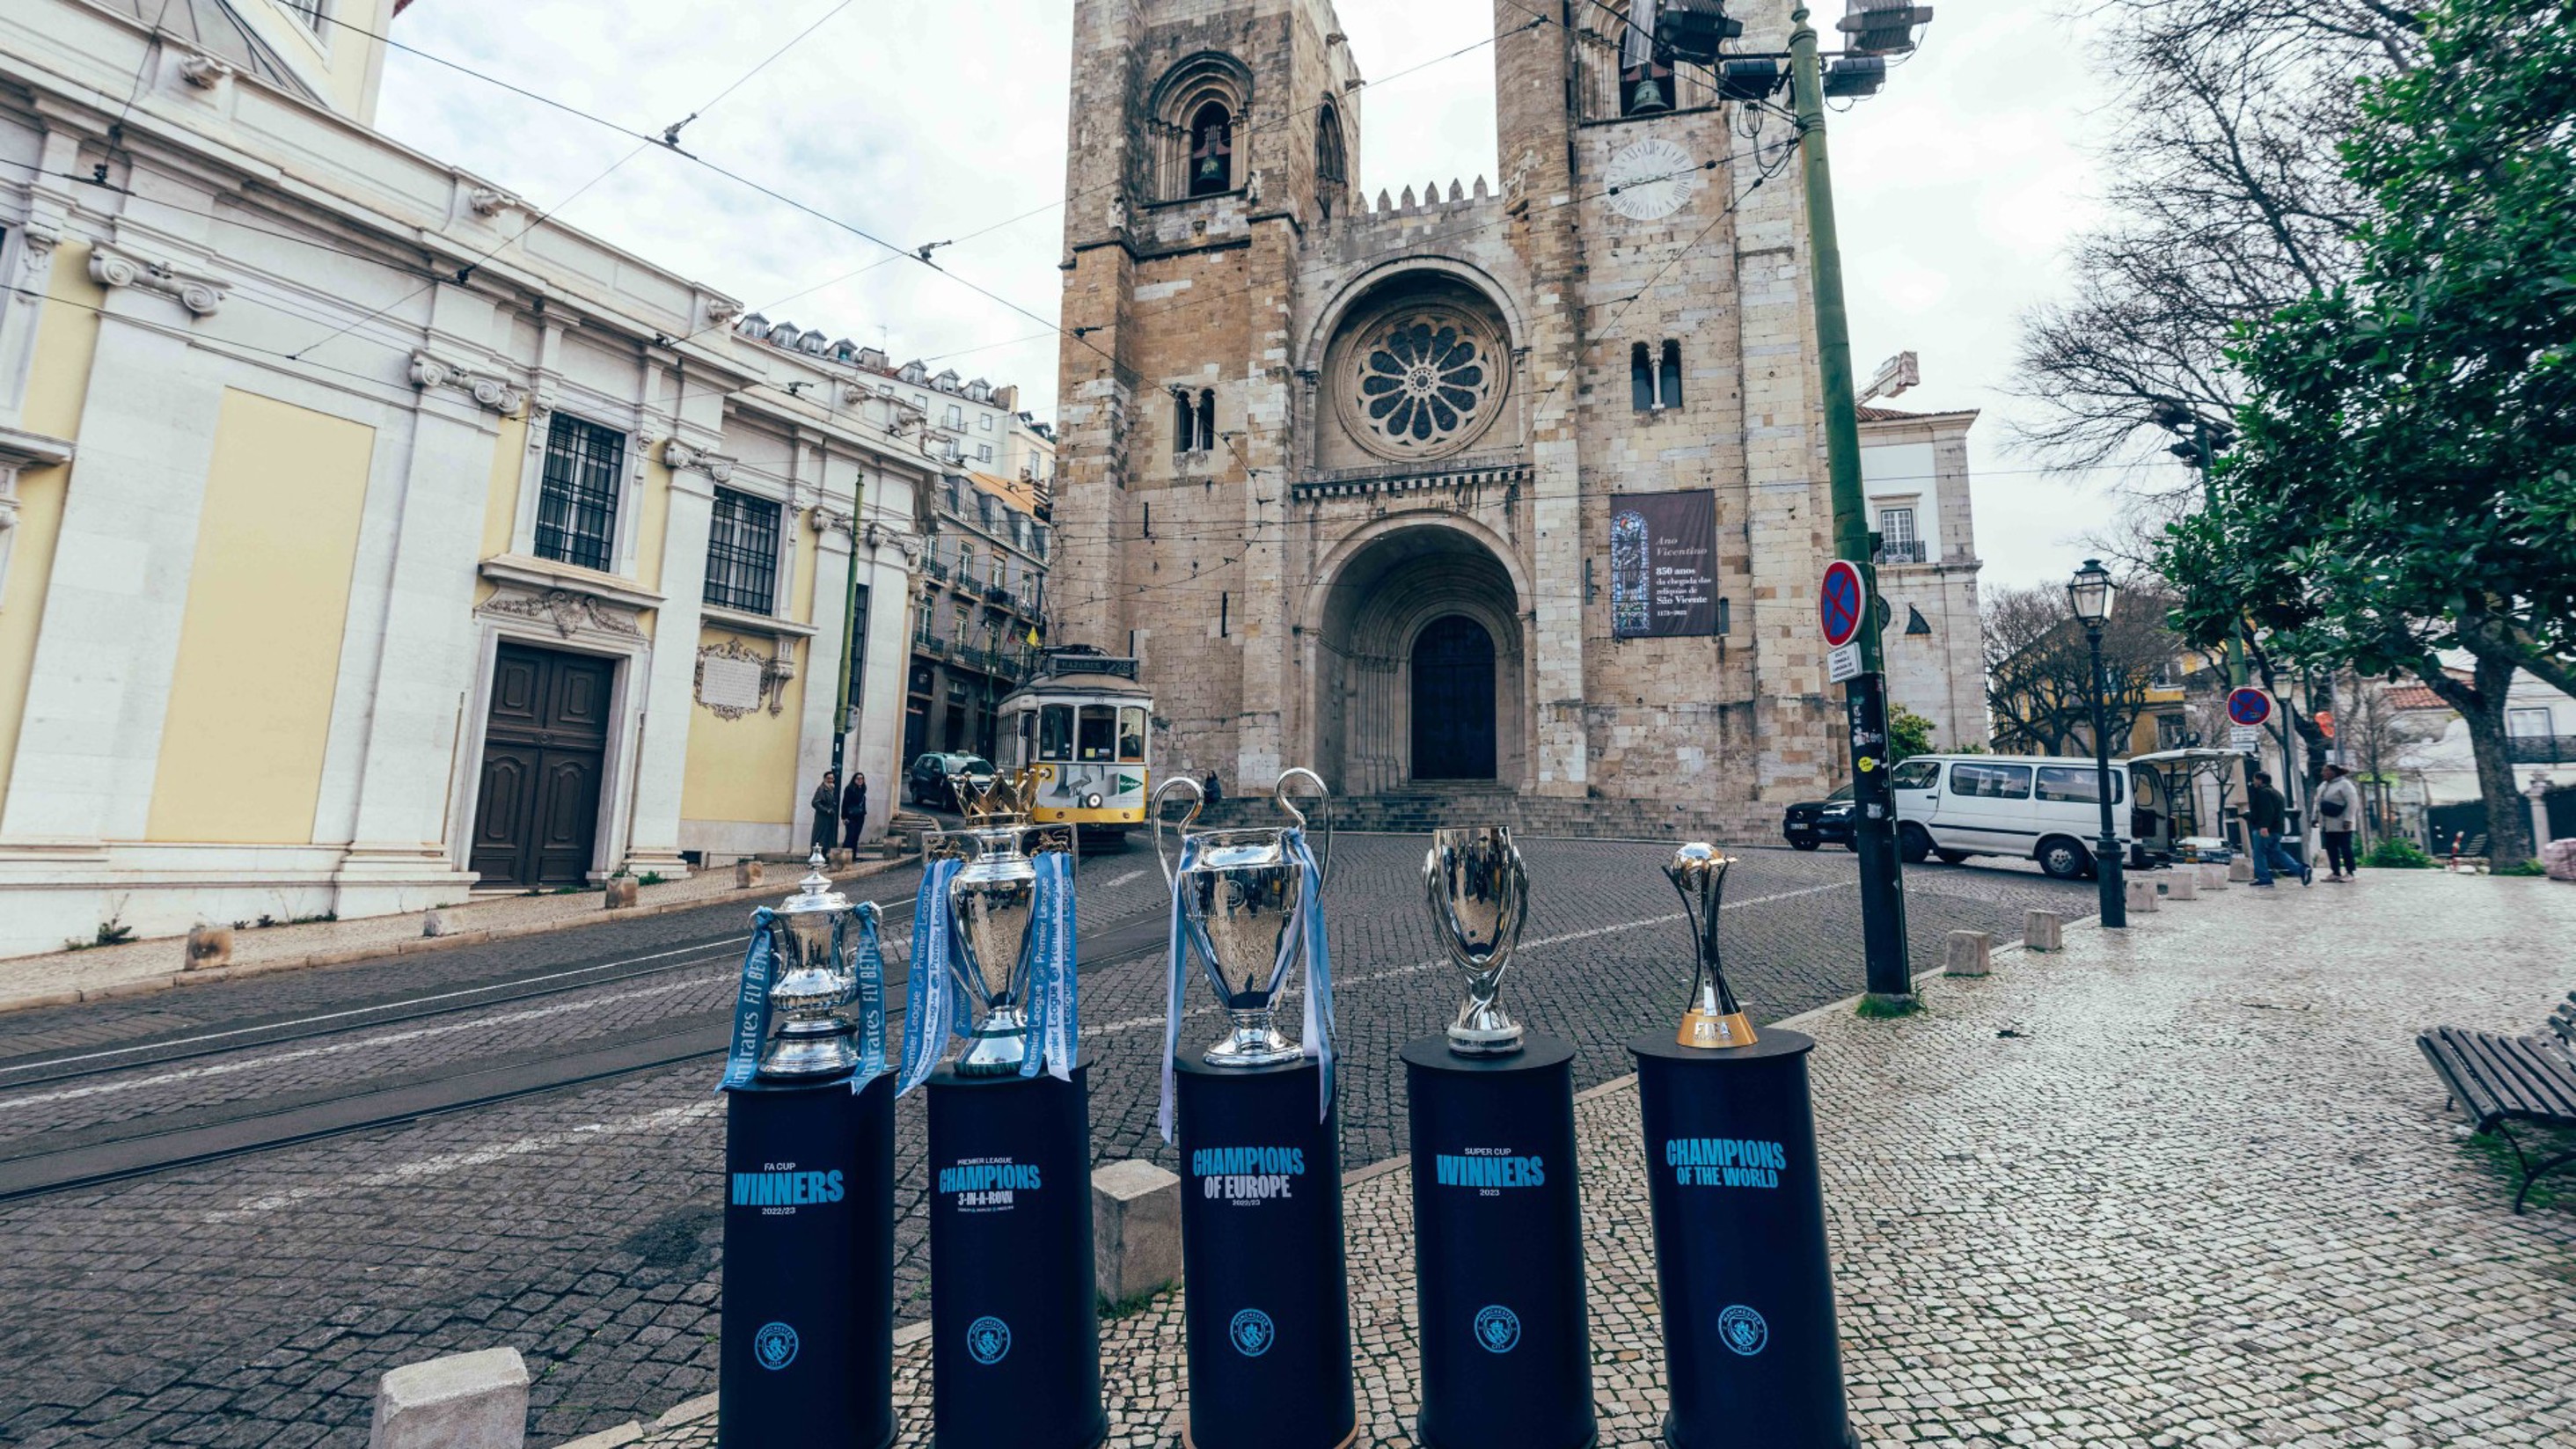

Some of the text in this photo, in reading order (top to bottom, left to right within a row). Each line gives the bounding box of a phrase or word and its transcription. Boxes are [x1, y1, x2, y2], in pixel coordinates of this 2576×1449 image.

[1657, 547, 1707, 556] Vicentino
[1667, 577, 1697, 586] chegada
[1657, 595, 1708, 604] São Vicente
[913, 884, 933, 970] Premier League
[1035, 876, 1050, 962] Premier League
[930, 930, 940, 971] Premier
[744, 982, 762, 1005] FLY
[861, 982, 878, 1002] FLY
[908, 991, 924, 1033] League
[956, 988, 967, 1028] Premier
[1024, 984, 1045, 1071] Premier League
[1047, 985, 1061, 1066] Premier League
[1193, 1147, 1304, 1176] CHAMPIONS
[1465, 1147, 1493, 1156] SUPER
[1666, 1138, 1786, 1170] CHAMPIONS
[940, 1165, 1042, 1193] CHAMPIONS
[1436, 1154, 1545, 1187] WINNERS
[1677, 1167, 1778, 1188] OF THE WORLD
[732, 1170, 845, 1205] WINNERS
[958, 1190, 1014, 1205] 3-IN-A-ROW
[1204, 1175, 1292, 1198] OF EUROPE
